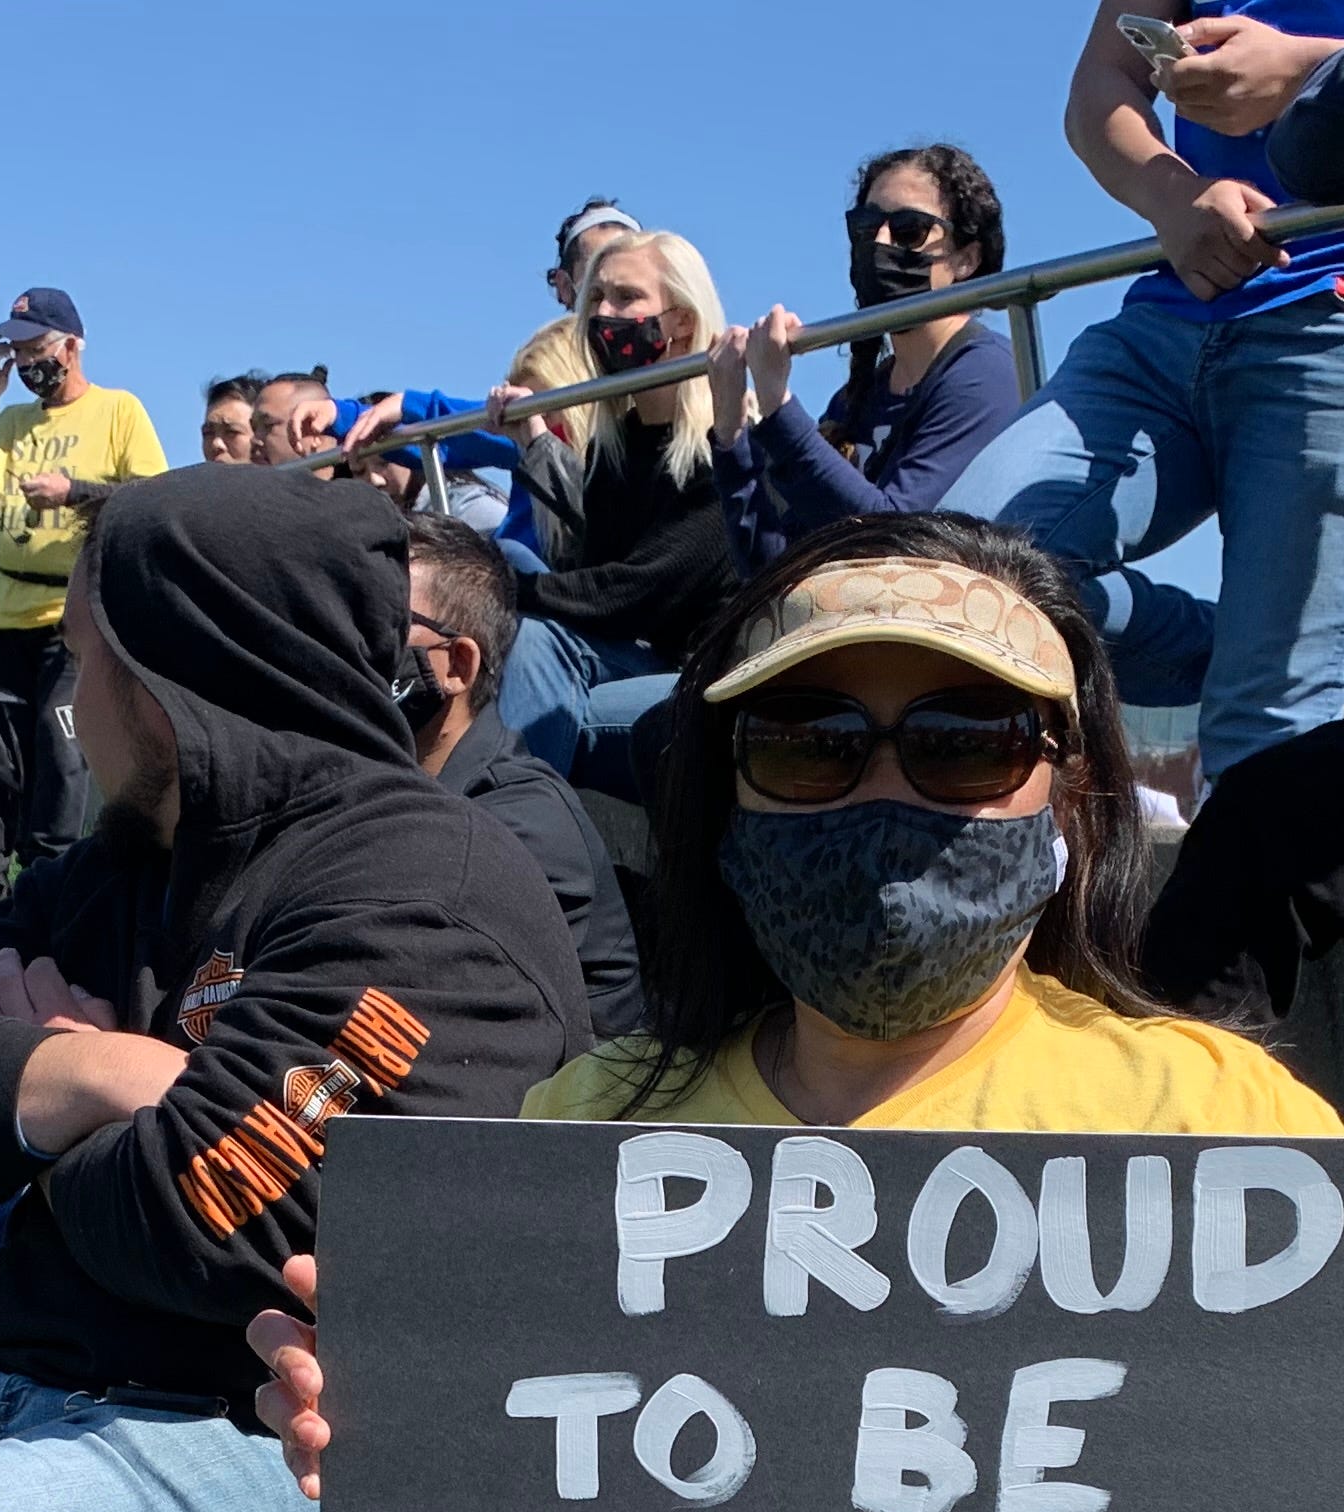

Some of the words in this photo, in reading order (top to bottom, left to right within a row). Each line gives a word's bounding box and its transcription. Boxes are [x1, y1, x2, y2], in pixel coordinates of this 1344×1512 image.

[12, 434, 79, 462] STOP
[615, 1132, 1344, 1318] PROUD
[505, 1371, 757, 1508] TO
